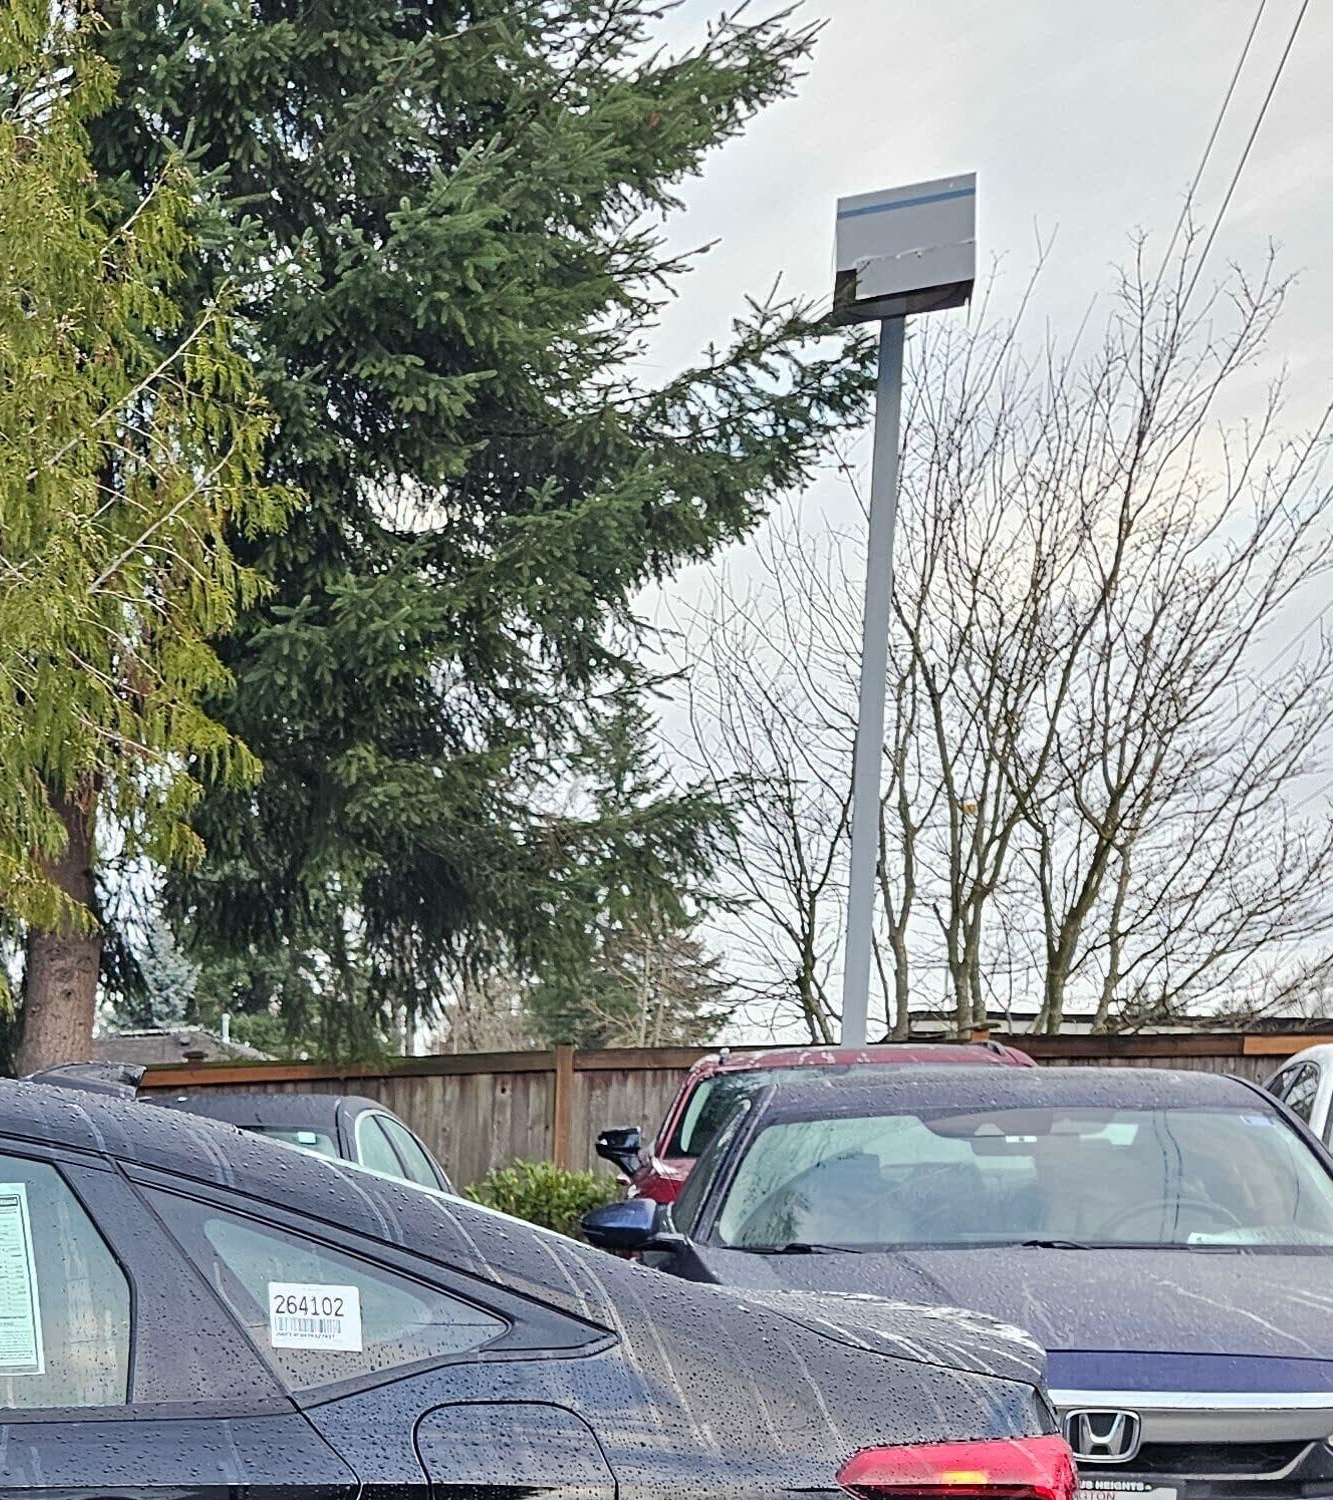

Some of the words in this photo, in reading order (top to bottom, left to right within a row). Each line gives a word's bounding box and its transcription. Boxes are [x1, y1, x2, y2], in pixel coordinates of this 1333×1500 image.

[274, 1295, 344, 1317] 264102
[1095, 1480, 1144, 1491] HEIGHTS
[1077, 1491, 1115, 1500] GTON
